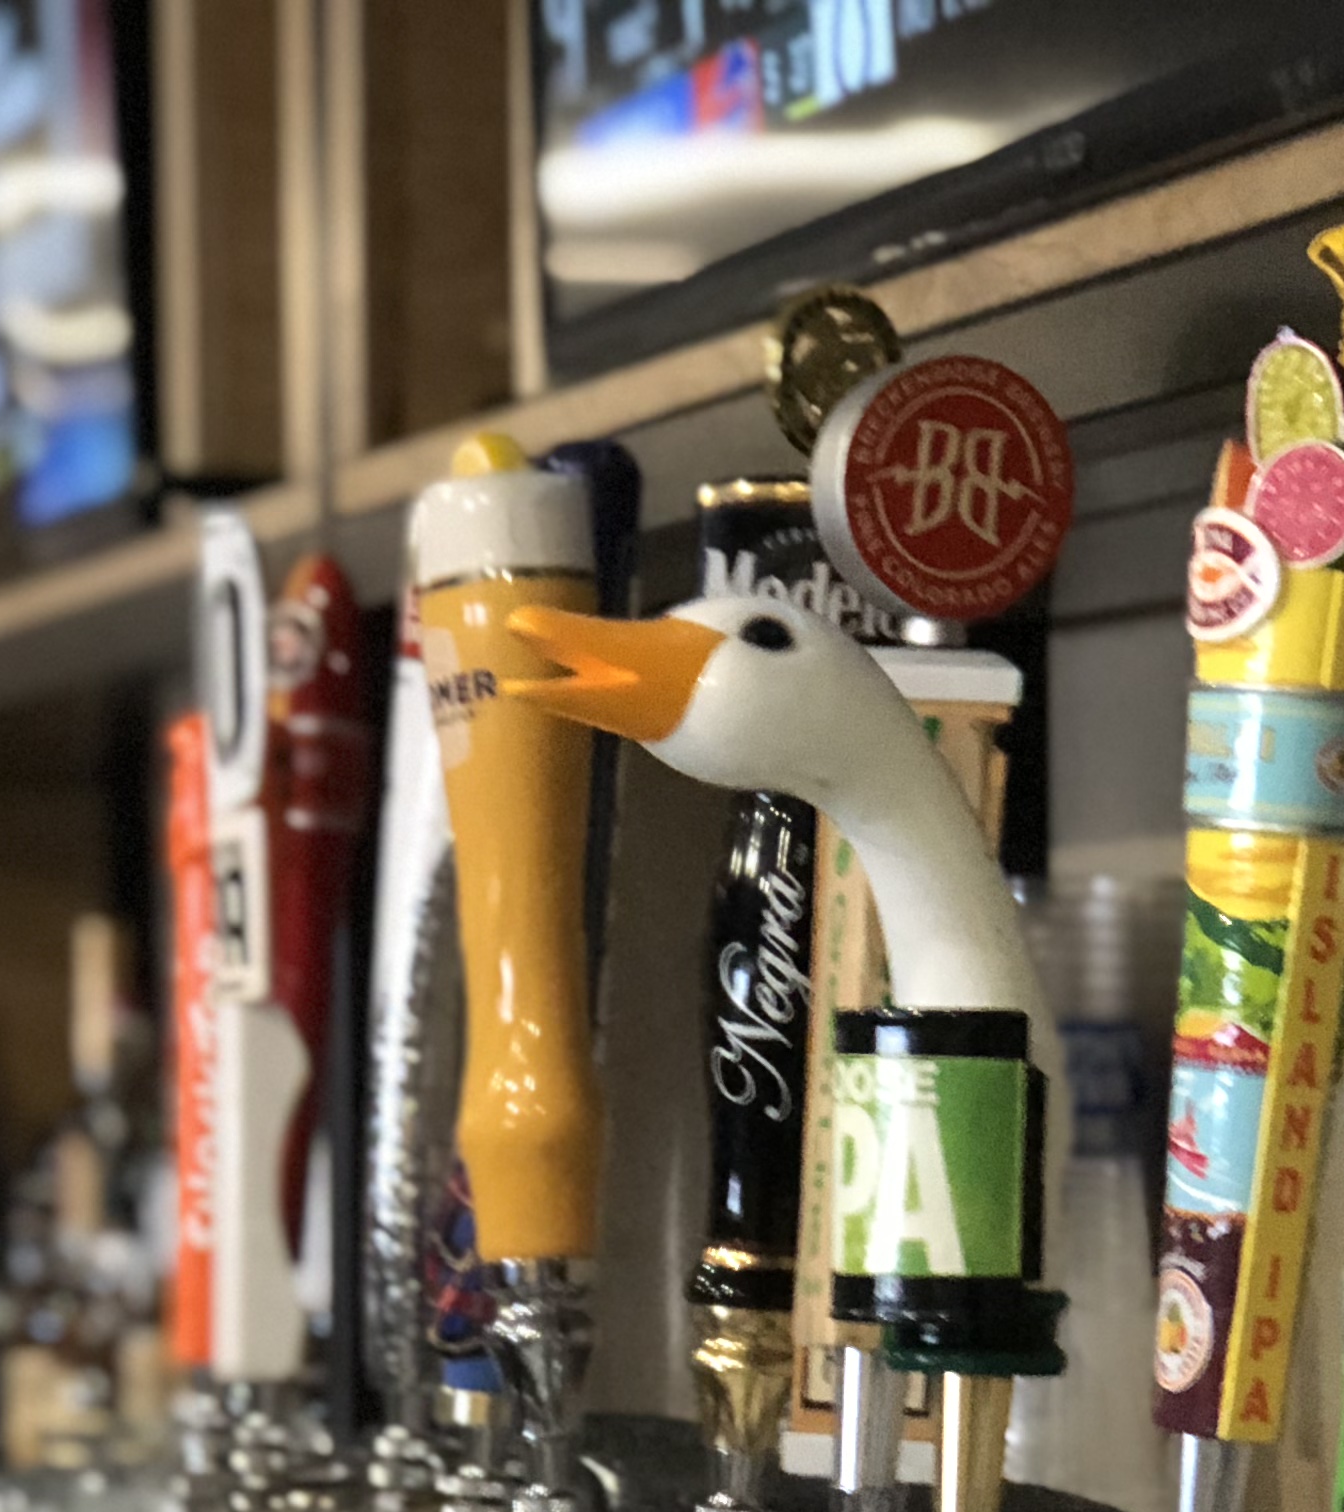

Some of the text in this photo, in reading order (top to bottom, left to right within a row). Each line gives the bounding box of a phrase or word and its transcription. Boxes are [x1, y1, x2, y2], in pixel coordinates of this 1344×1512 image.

[712, 866, 816, 1123] Negra
[1238, 853, 1341, 1425] ISLAND IPA
